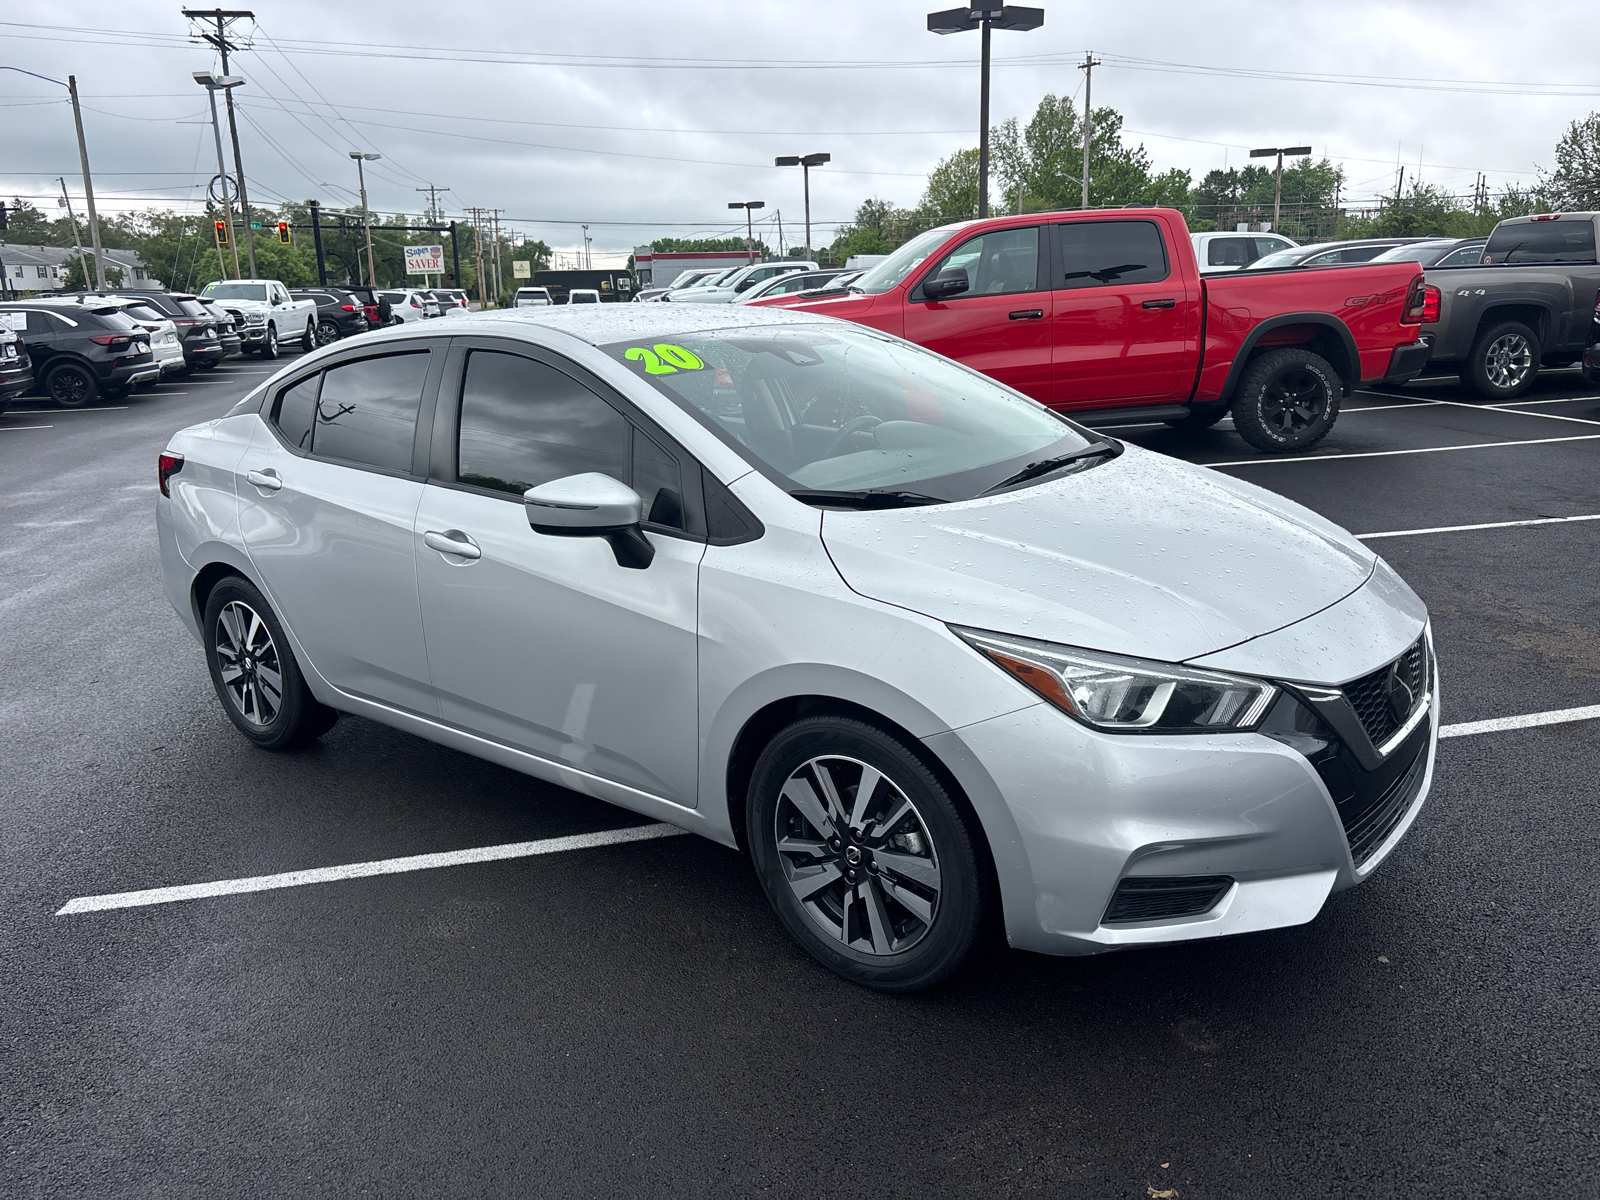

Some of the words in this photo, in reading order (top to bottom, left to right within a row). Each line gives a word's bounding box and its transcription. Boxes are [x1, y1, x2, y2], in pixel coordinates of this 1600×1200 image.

[406, 247, 429, 258] Super
[408, 258, 439, 269] SAVER
[624, 344, 704, 375] 20
